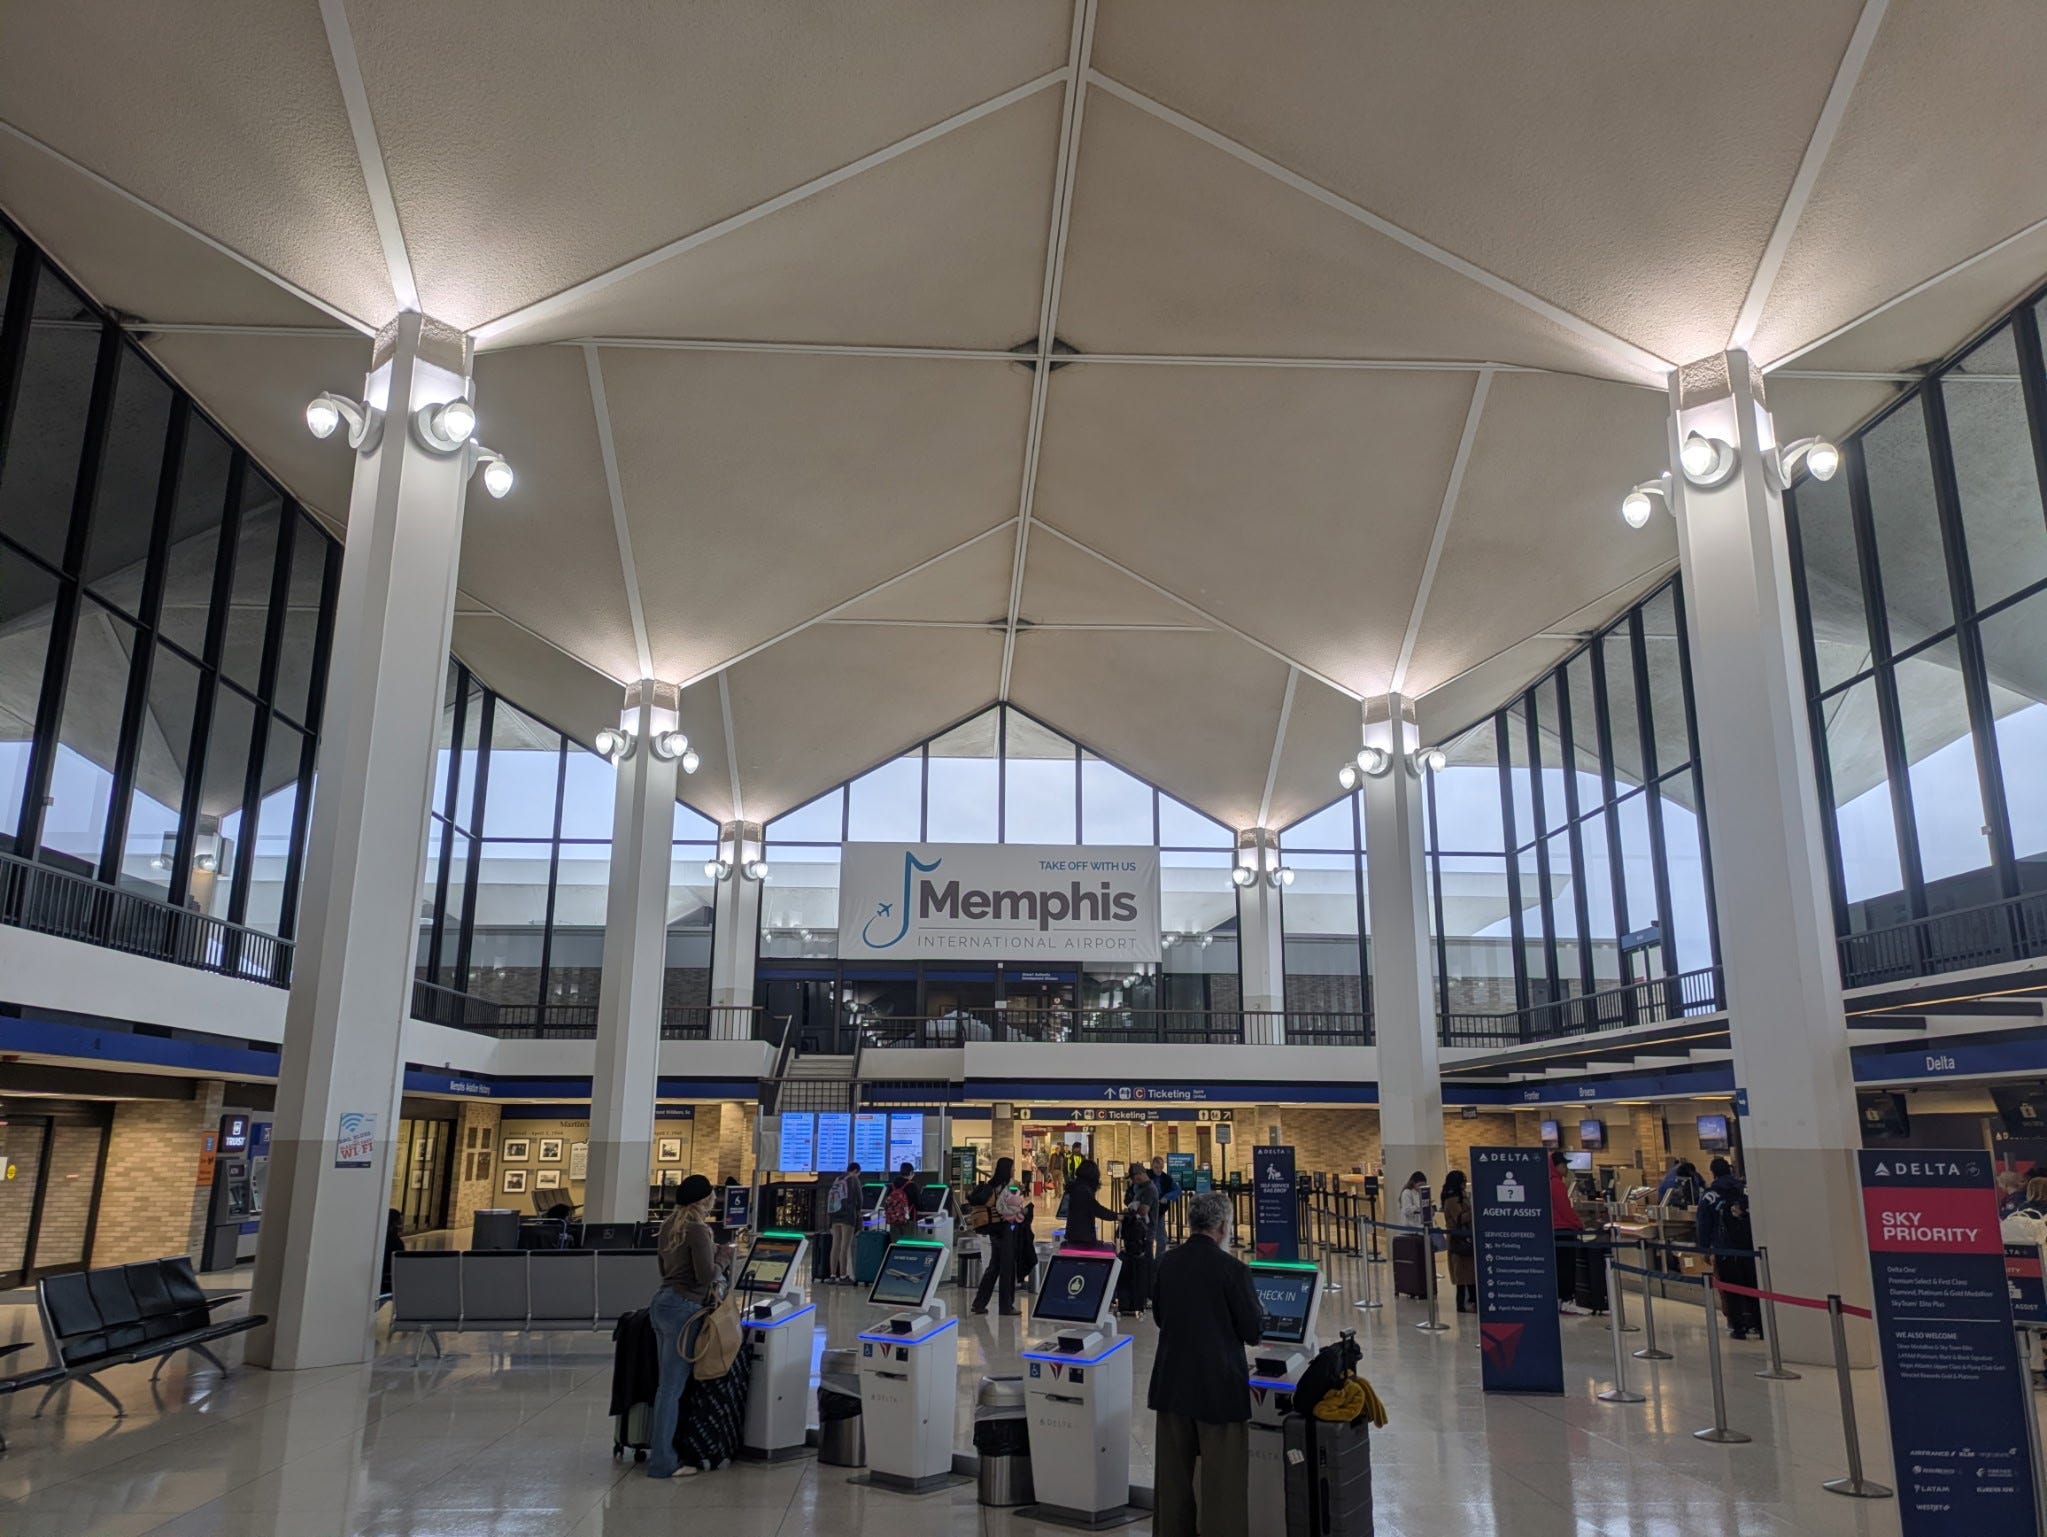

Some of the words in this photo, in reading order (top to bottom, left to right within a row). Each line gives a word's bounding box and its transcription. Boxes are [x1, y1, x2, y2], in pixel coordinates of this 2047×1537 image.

[1039, 861, 1066, 871] TAKE
[1068, 861, 1089, 871] OFF
[1091, 862, 1119, 871] WITH
[1121, 863, 1136, 872] US
[920, 880, 1138, 931] Memphis
[918, 936, 1057, 949] INTERNATIONAL
[1065, 938, 1137, 949] AIRPORT
[1926, 1056, 1955, 1071] Delta
[1148, 1090, 1191, 1100] Ticketing
[1109, 1111, 1146, 1120] Ticketing
[1491, 1153, 1529, 1162] DELTA
[1895, 1163, 1960, 1176] DELTA
[1483, 1208, 1511, 1217] AGENT
[1513, 1208, 1541, 1217] ASSIST
[1881, 1211, 1922, 1226] SKY
[1883, 1227, 1978, 1242] PRIORITY
[1888, 1277, 1914, 1285] Premium
[1285, 1291, 1297, 1302] IN
[1918, 1289, 1944, 1297] Platinum
[1950, 1289, 1964, 1297] Gold
[1965, 1289, 1993, 1298] Medallion
[1925, 1332, 1957, 1340] WELCOME
[1916, 1504, 1943, 1512] WESTJET
